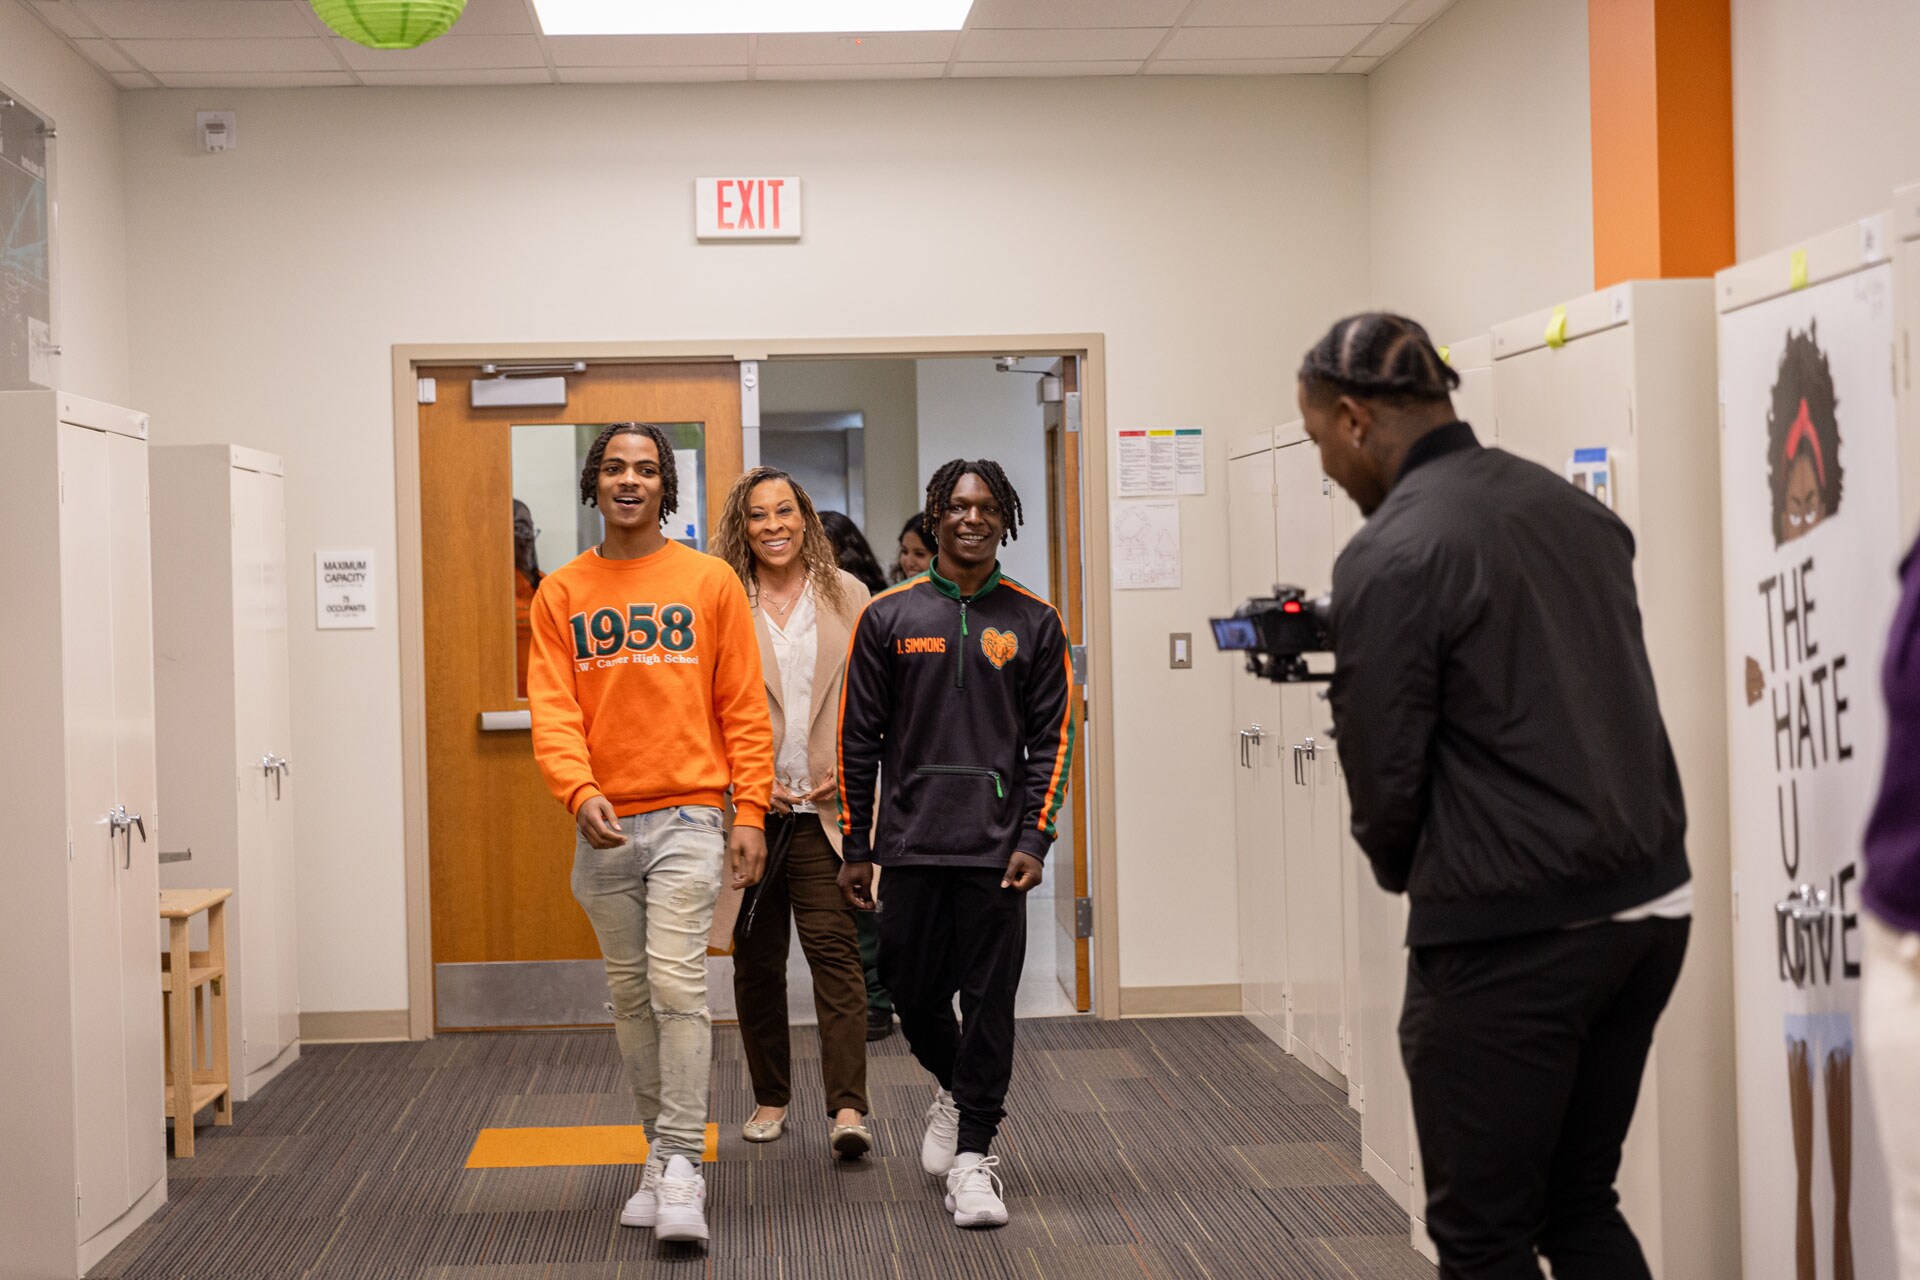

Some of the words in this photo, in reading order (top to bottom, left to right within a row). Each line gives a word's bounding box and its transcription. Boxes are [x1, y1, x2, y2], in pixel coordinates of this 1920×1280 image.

[717, 180, 784, 229] EXIT
[324, 561, 366, 571] MAXIMUM
[324, 573, 366, 583] CAPACITY
[326, 604, 366, 613] OCCUPANTS
[1758, 556, 1818, 673] THE
[569, 603, 697, 662] 1958
[905, 637, 946, 653] SIMMONS
[632, 654, 661, 666] High
[1772, 655, 1852, 772] HATE
[1778, 778, 1799, 880] U
